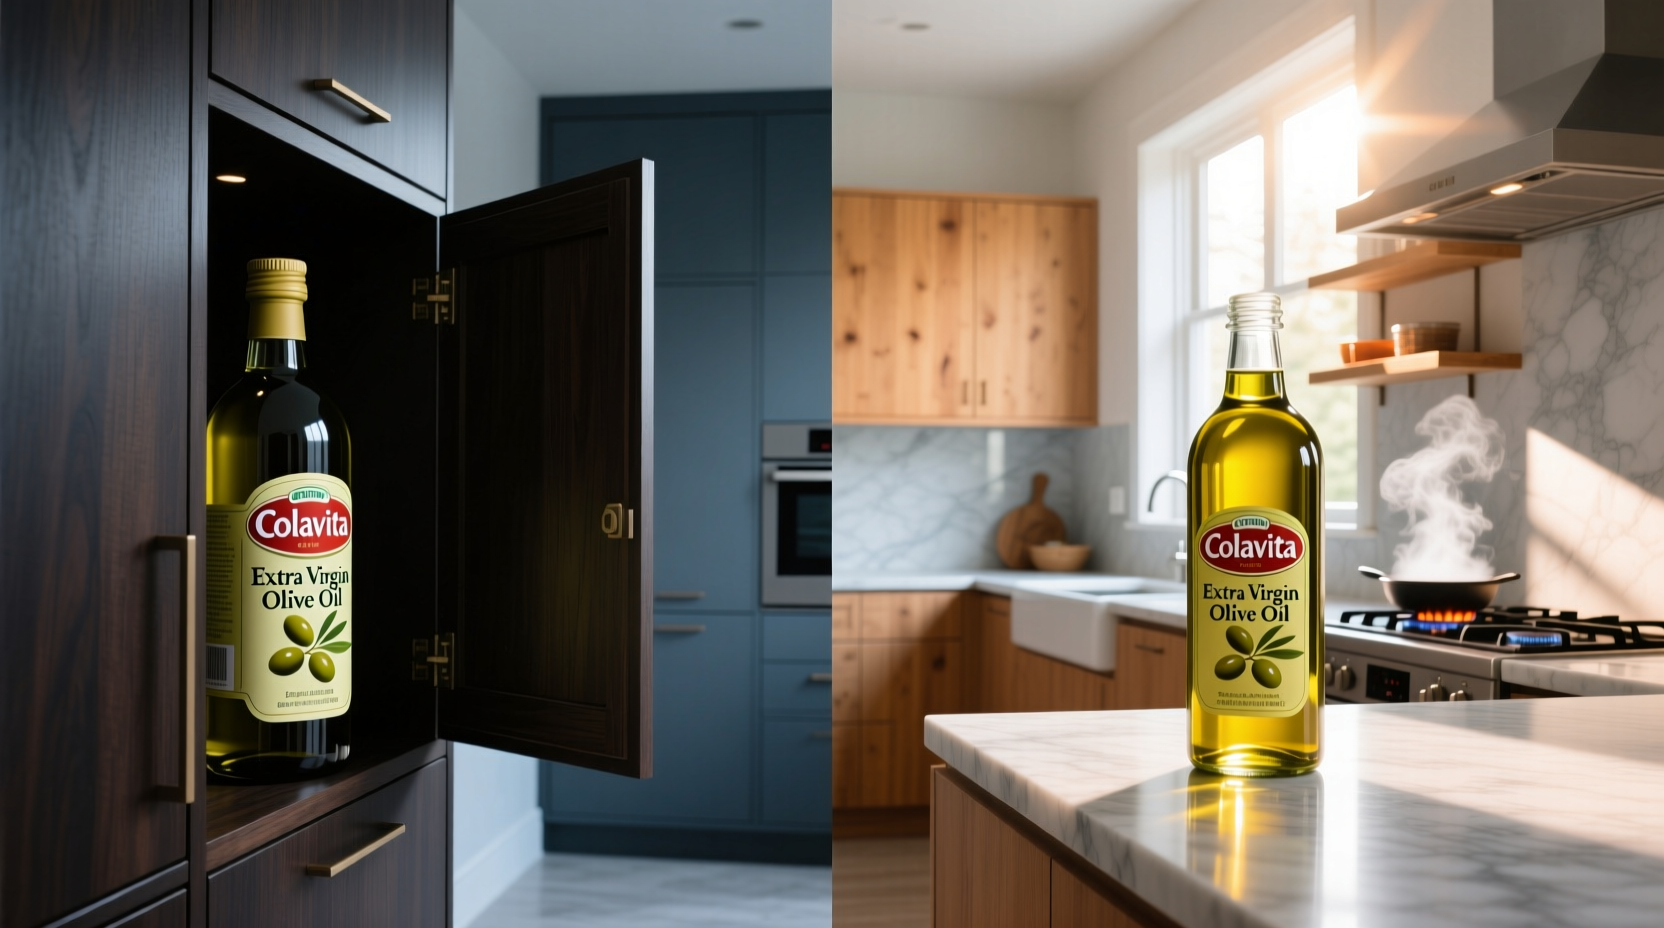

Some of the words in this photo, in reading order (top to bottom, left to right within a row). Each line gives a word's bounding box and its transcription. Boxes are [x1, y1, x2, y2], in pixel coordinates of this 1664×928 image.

[255, 508, 348, 539] Colavita
[1204, 532, 1297, 559] Colavita
[251, 566, 303, 586] Extra
[306, 565, 349, 591] Virgin
[262, 589, 315, 610] Olive
[318, 587, 342, 608] Oil
[1203, 583, 1245, 600] Extra
[1248, 583, 1299, 606] Virgin
[1209, 603, 1257, 622] Olive
[1261, 604, 1289, 622] Oil
